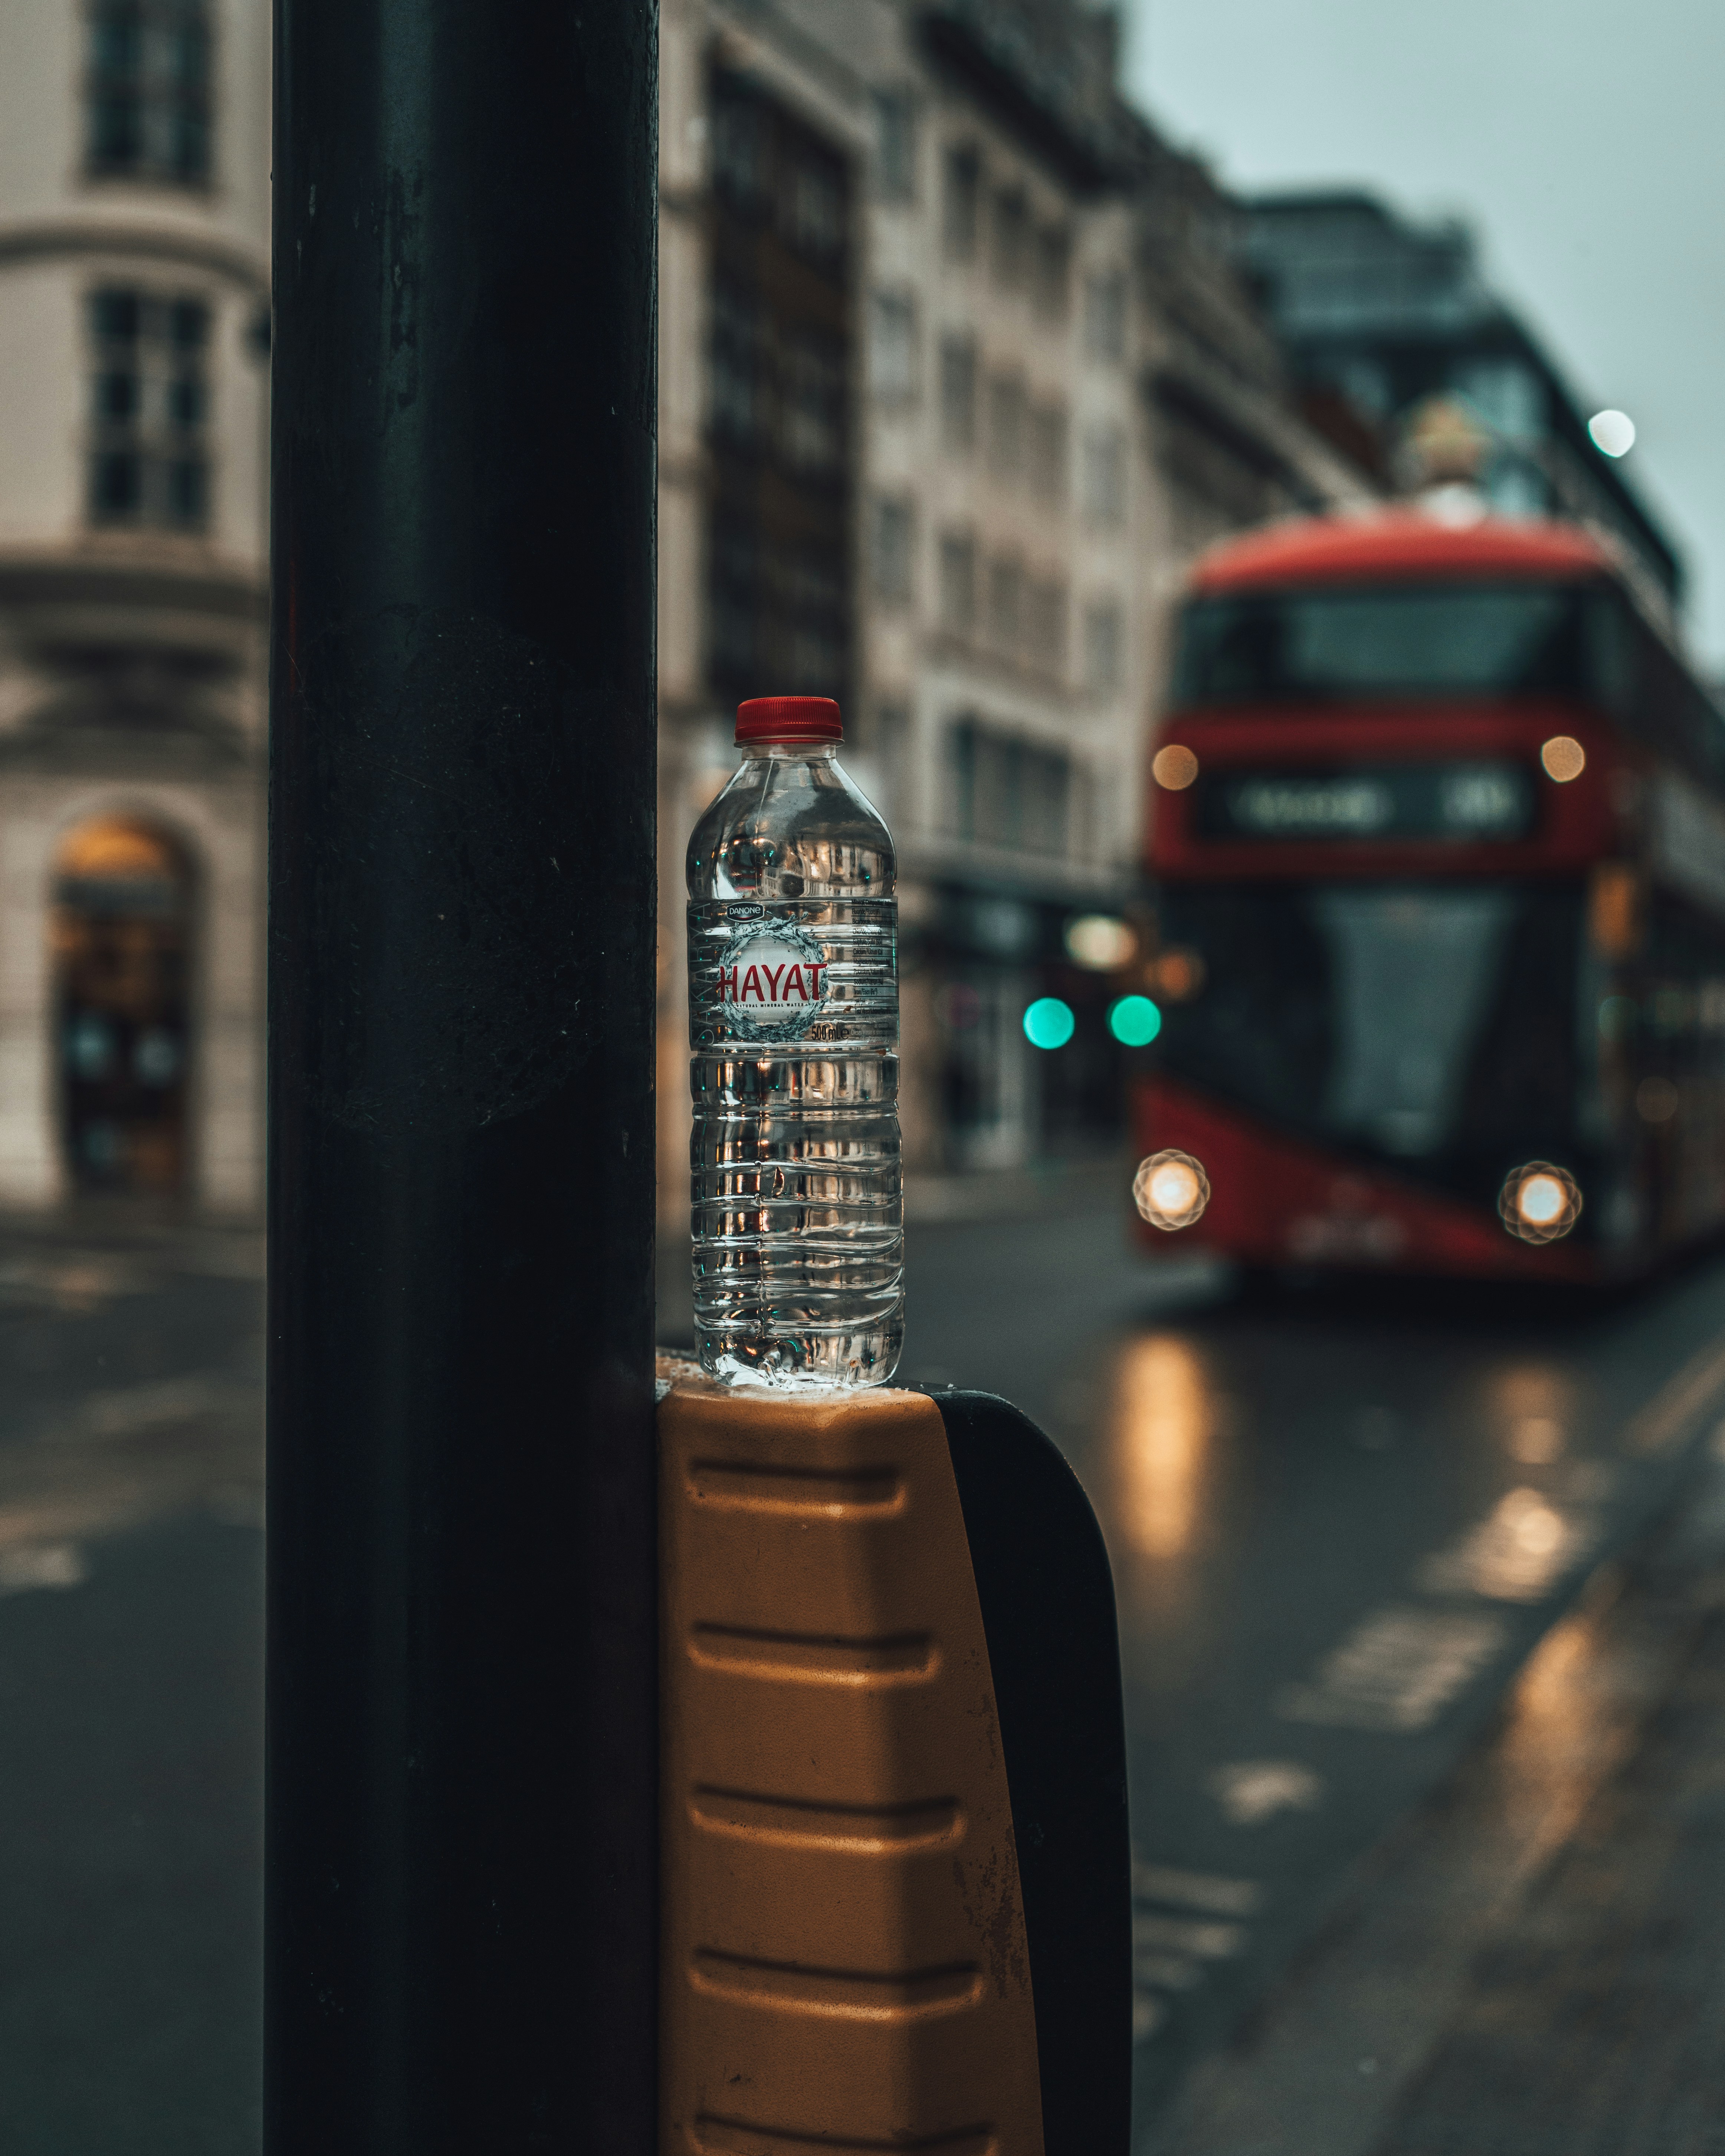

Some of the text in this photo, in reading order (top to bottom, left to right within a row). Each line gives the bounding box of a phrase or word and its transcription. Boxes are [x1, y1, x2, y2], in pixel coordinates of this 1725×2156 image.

[729, 906, 761, 915] DANONE
[716, 963, 828, 1003] HAYAT
[811, 1025, 826, 1040] 500
[829, 1025, 840, 1040] mL
